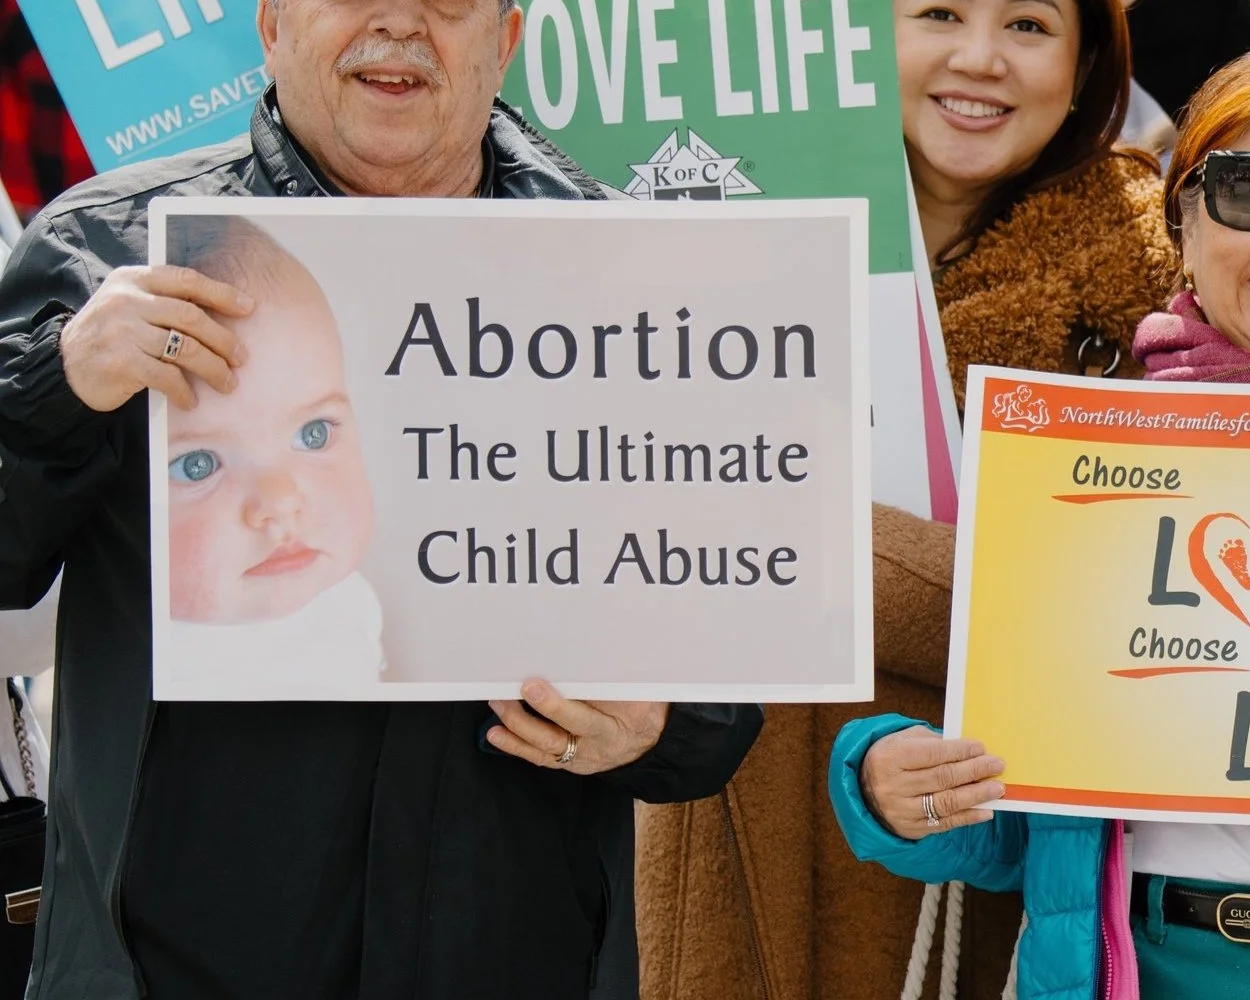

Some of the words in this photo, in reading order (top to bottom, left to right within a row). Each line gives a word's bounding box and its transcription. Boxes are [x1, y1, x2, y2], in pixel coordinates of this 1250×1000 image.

[653, 166, 673, 187] K
[702, 163, 720, 184] C
[384, 297, 817, 382] Abortion
[402, 423, 518, 482] The
[545, 425, 810, 484] Ultimate
[1071, 454, 1182, 492] Choose
[417, 527, 581, 586] Child
[603, 528, 799, 587] Abuse
[1127, 626, 1240, 663] Choose
